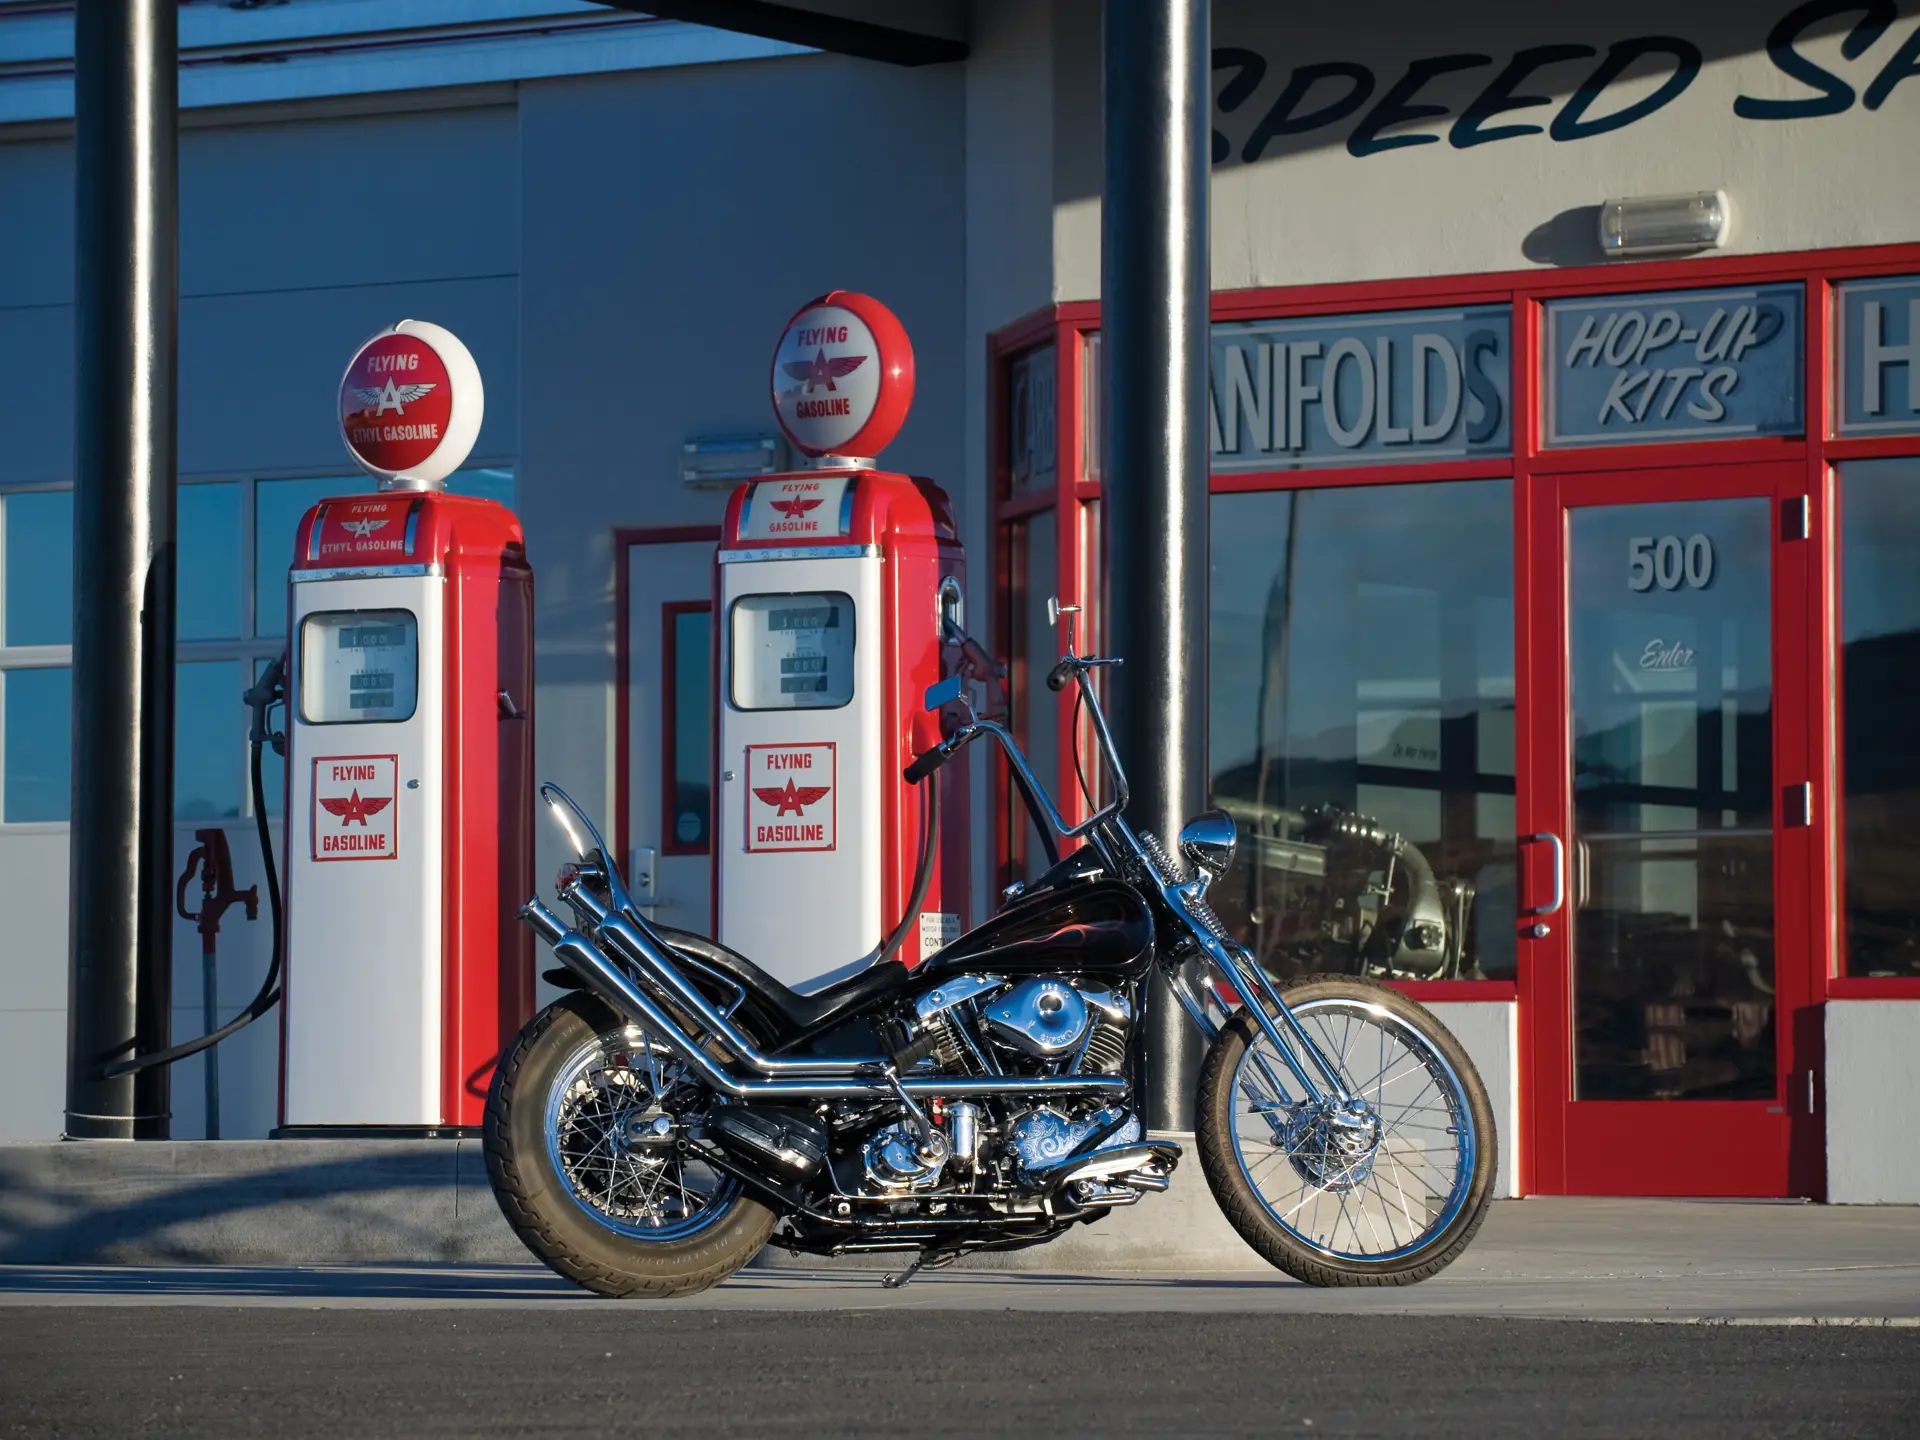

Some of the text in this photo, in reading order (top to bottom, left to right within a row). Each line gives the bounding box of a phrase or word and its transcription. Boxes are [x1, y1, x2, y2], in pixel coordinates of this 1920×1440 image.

[797, 326, 848, 346] FLYING
[1565, 302, 1785, 368] HOP-UP
[367, 353, 419, 373] FLYING
[1210, 329, 1501, 455] NIFOLDS
[1598, 366, 1741, 425] KITS
[796, 398, 851, 419] GASOLINE
[352, 423, 439, 443] ETHYL GASOLINE
[781, 483, 820, 492] FLYING
[351, 504, 388, 513] FLYING
[769, 521, 818, 533] GASOLINE
[322, 540, 404, 554] ETHYL GASOLINE
[1628, 533, 1716, 593] 500
[1639, 638, 1695, 669] Enter
[767, 753, 812, 770] FLYING
[333, 765, 375, 781] FLYING
[323, 834, 386, 852] GASOLINE
[757, 824, 824, 842] GASOLINE
